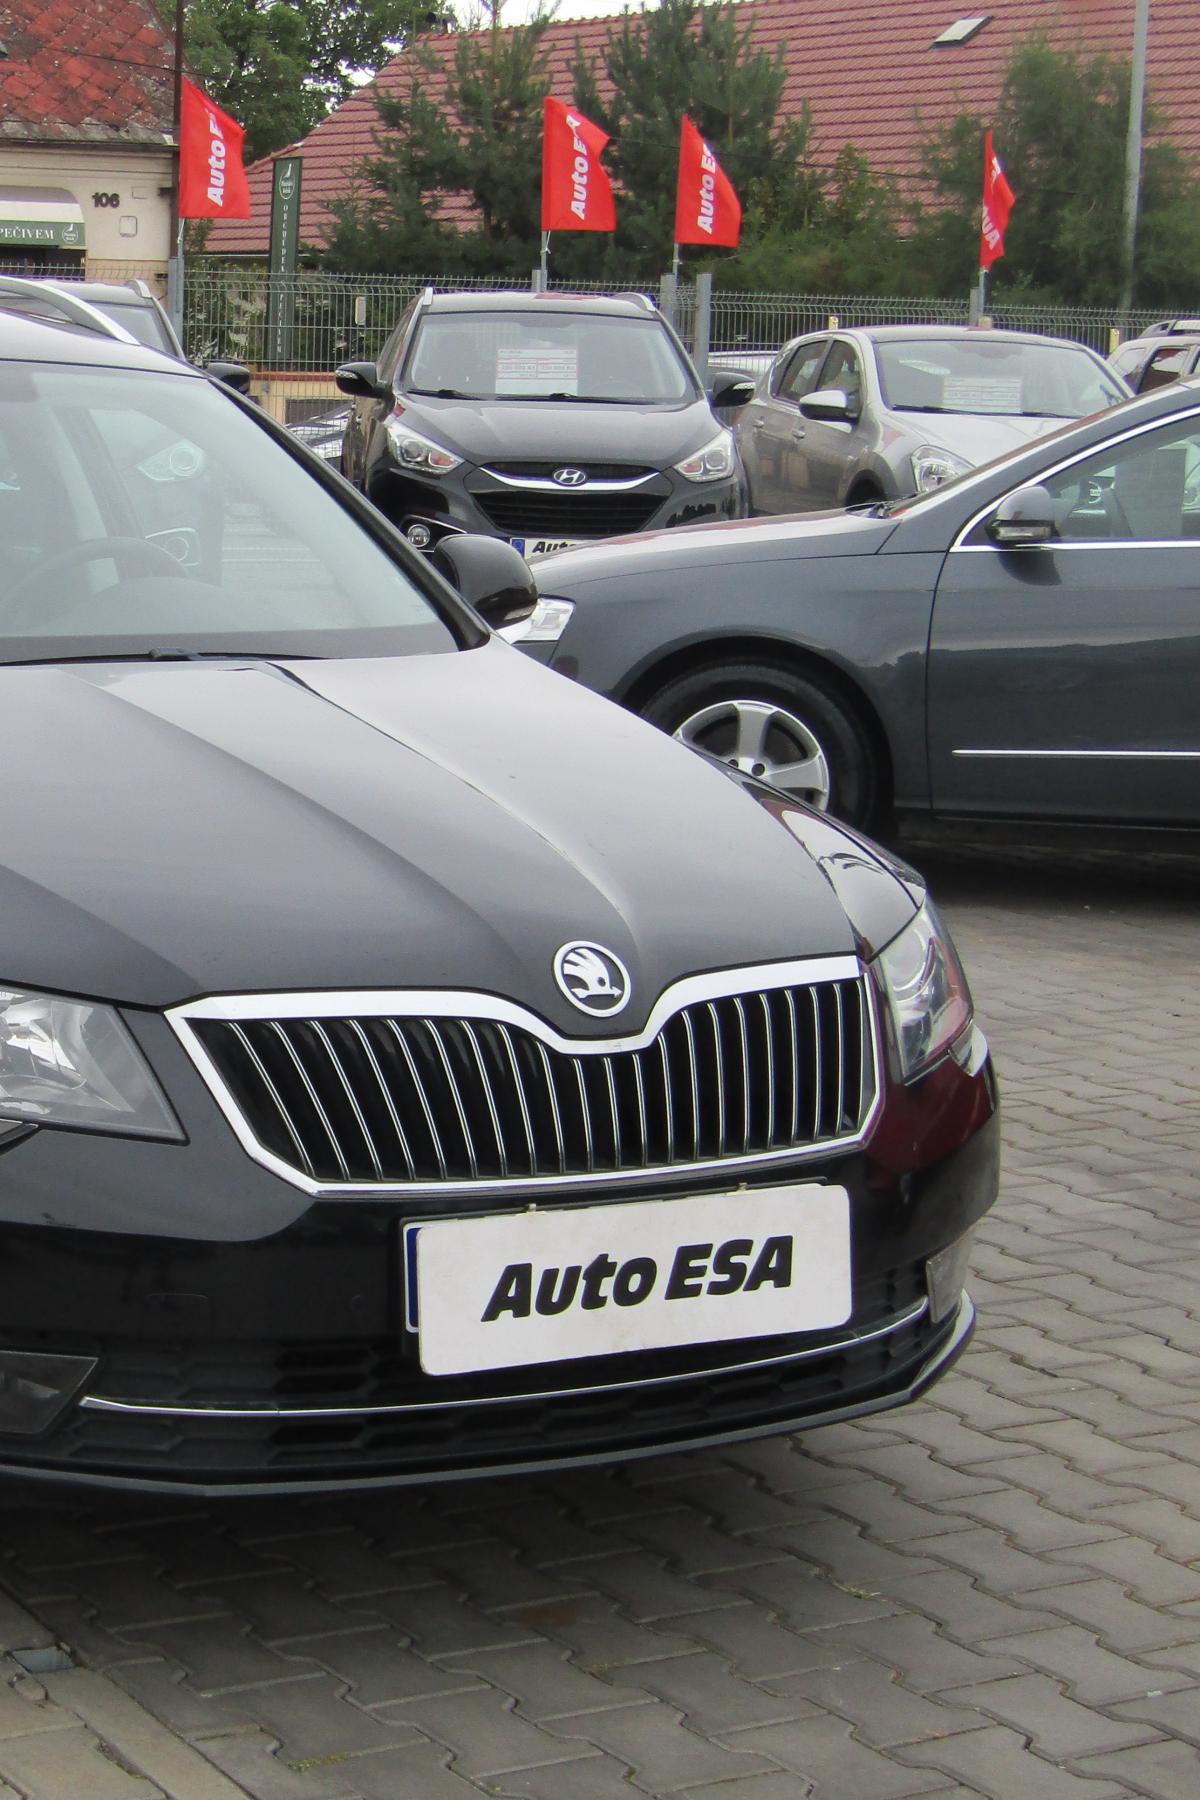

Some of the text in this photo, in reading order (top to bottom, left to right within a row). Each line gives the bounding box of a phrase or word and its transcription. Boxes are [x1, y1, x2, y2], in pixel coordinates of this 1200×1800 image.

[92, 192, 121, 209] 106
[207, 139, 226, 208] Auto
[570, 156, 589, 221] Auto
[697, 174, 715, 235] Auto
[481, 1235, 793, 1322] Auto ESA
